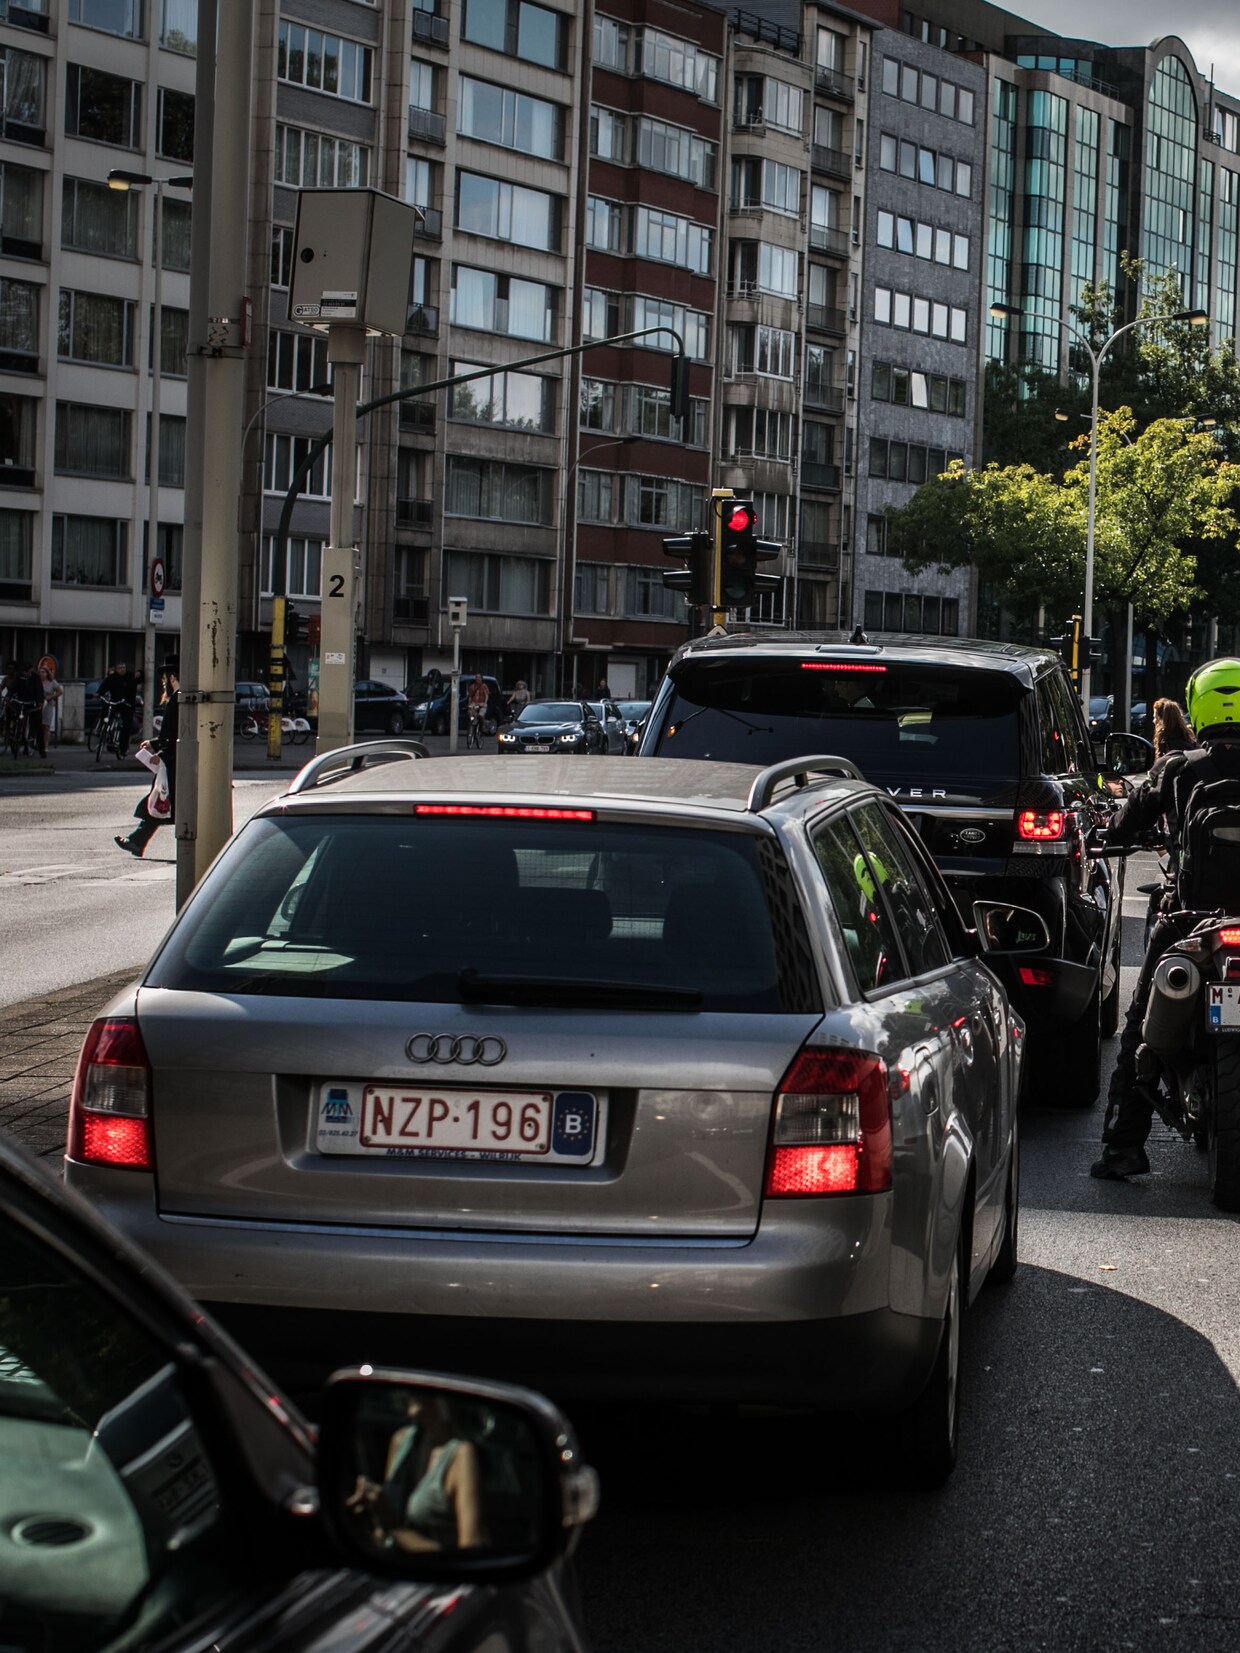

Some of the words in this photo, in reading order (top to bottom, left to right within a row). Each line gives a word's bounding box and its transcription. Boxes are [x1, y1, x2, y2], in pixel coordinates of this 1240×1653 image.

[329, 574, 345, 597] 2
[886, 787, 947, 798] VER
[565, 1114, 582, 1134] B
[386, 1148, 415, 1156] M&M
[419, 1149, 465, 1159] SERVICES
[479, 1151, 521, 1161] WILRIJK
